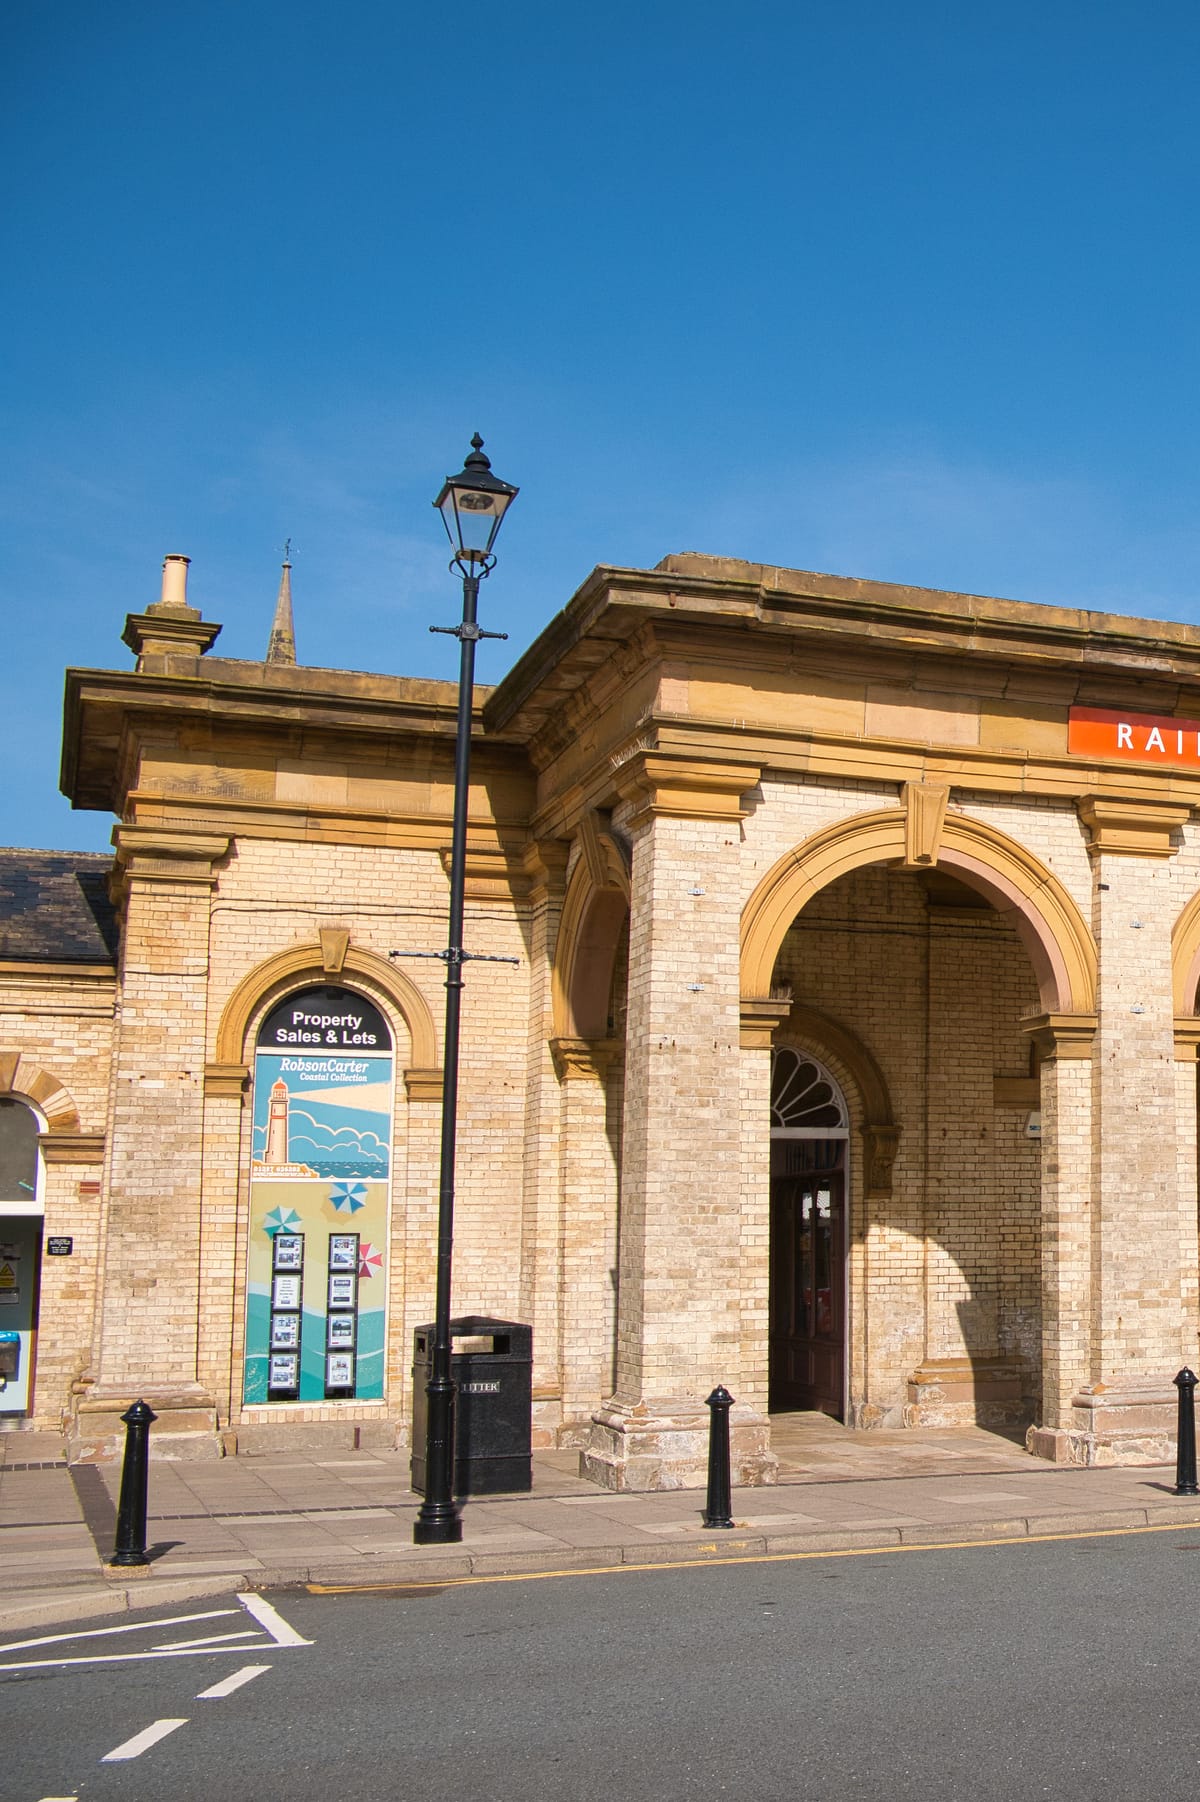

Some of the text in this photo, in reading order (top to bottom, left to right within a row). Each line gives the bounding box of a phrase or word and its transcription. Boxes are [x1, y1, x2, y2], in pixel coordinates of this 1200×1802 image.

[292, 1011, 362, 1030] Property
[276, 1028, 377, 1045] Sales & Lets
[280, 1057, 369, 1073] RobsonCarter
[300, 1072, 367, 1082] Coastal Collection
